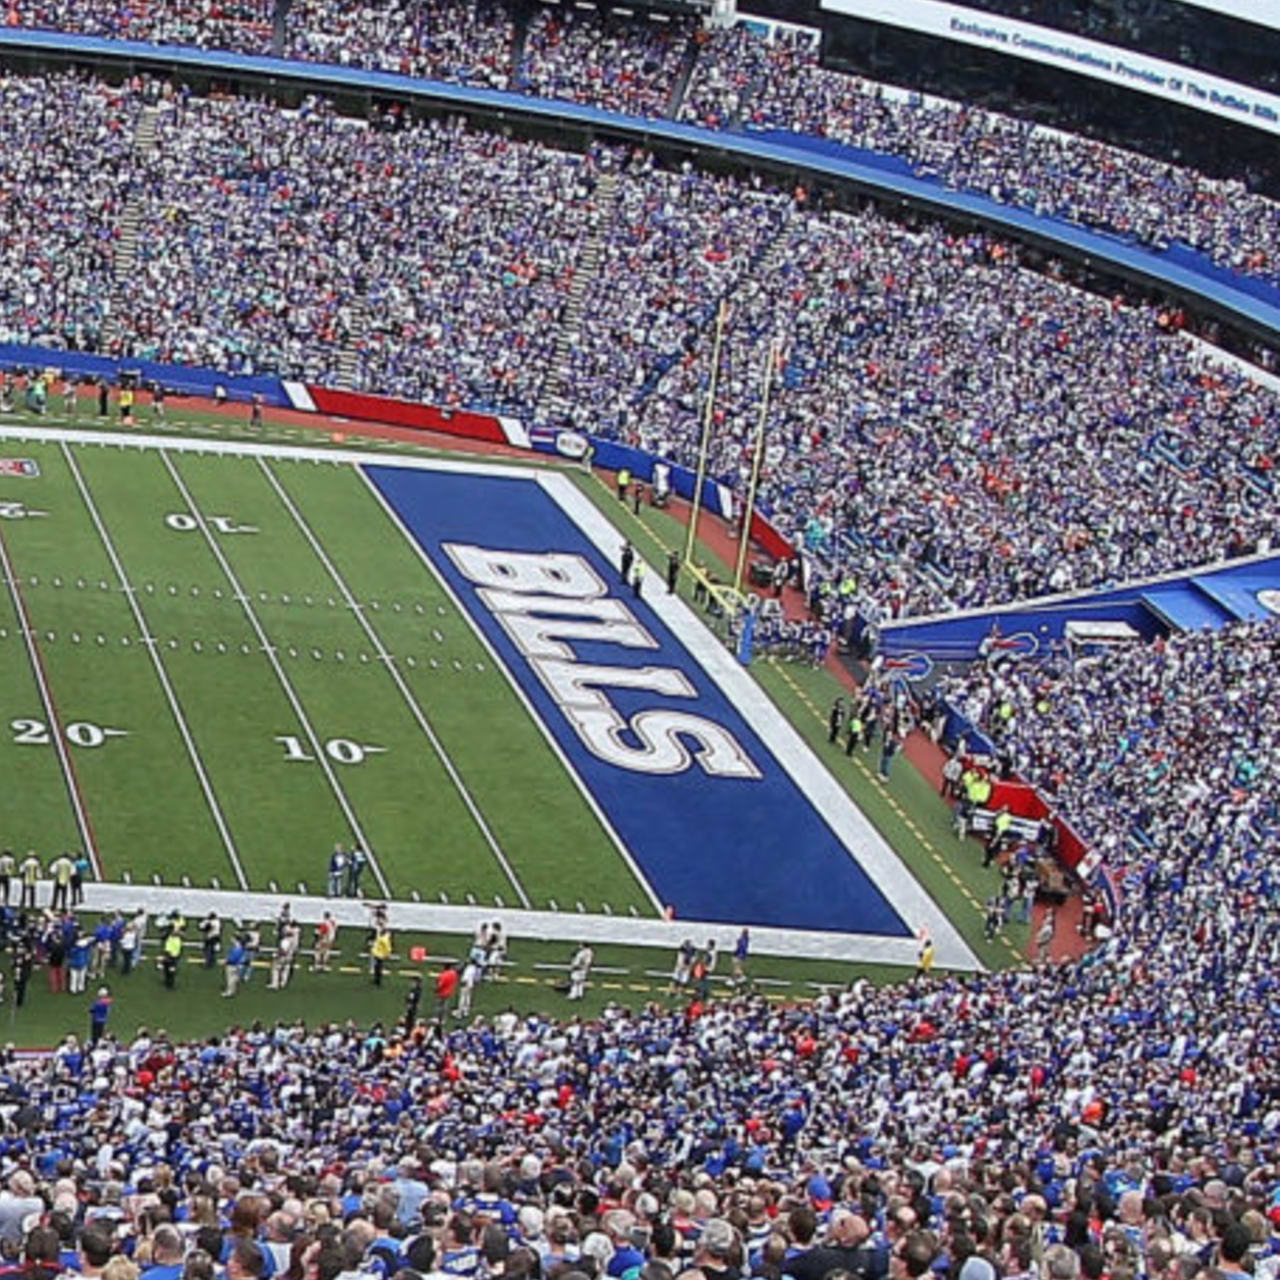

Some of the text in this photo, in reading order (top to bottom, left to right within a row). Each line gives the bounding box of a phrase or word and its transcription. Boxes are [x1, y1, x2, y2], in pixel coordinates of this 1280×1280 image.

[165, 513, 242, 533] 10
[441, 541, 764, 779] BILLS
[9, 718, 109, 748] 20
[272, 734, 367, 766] 10
